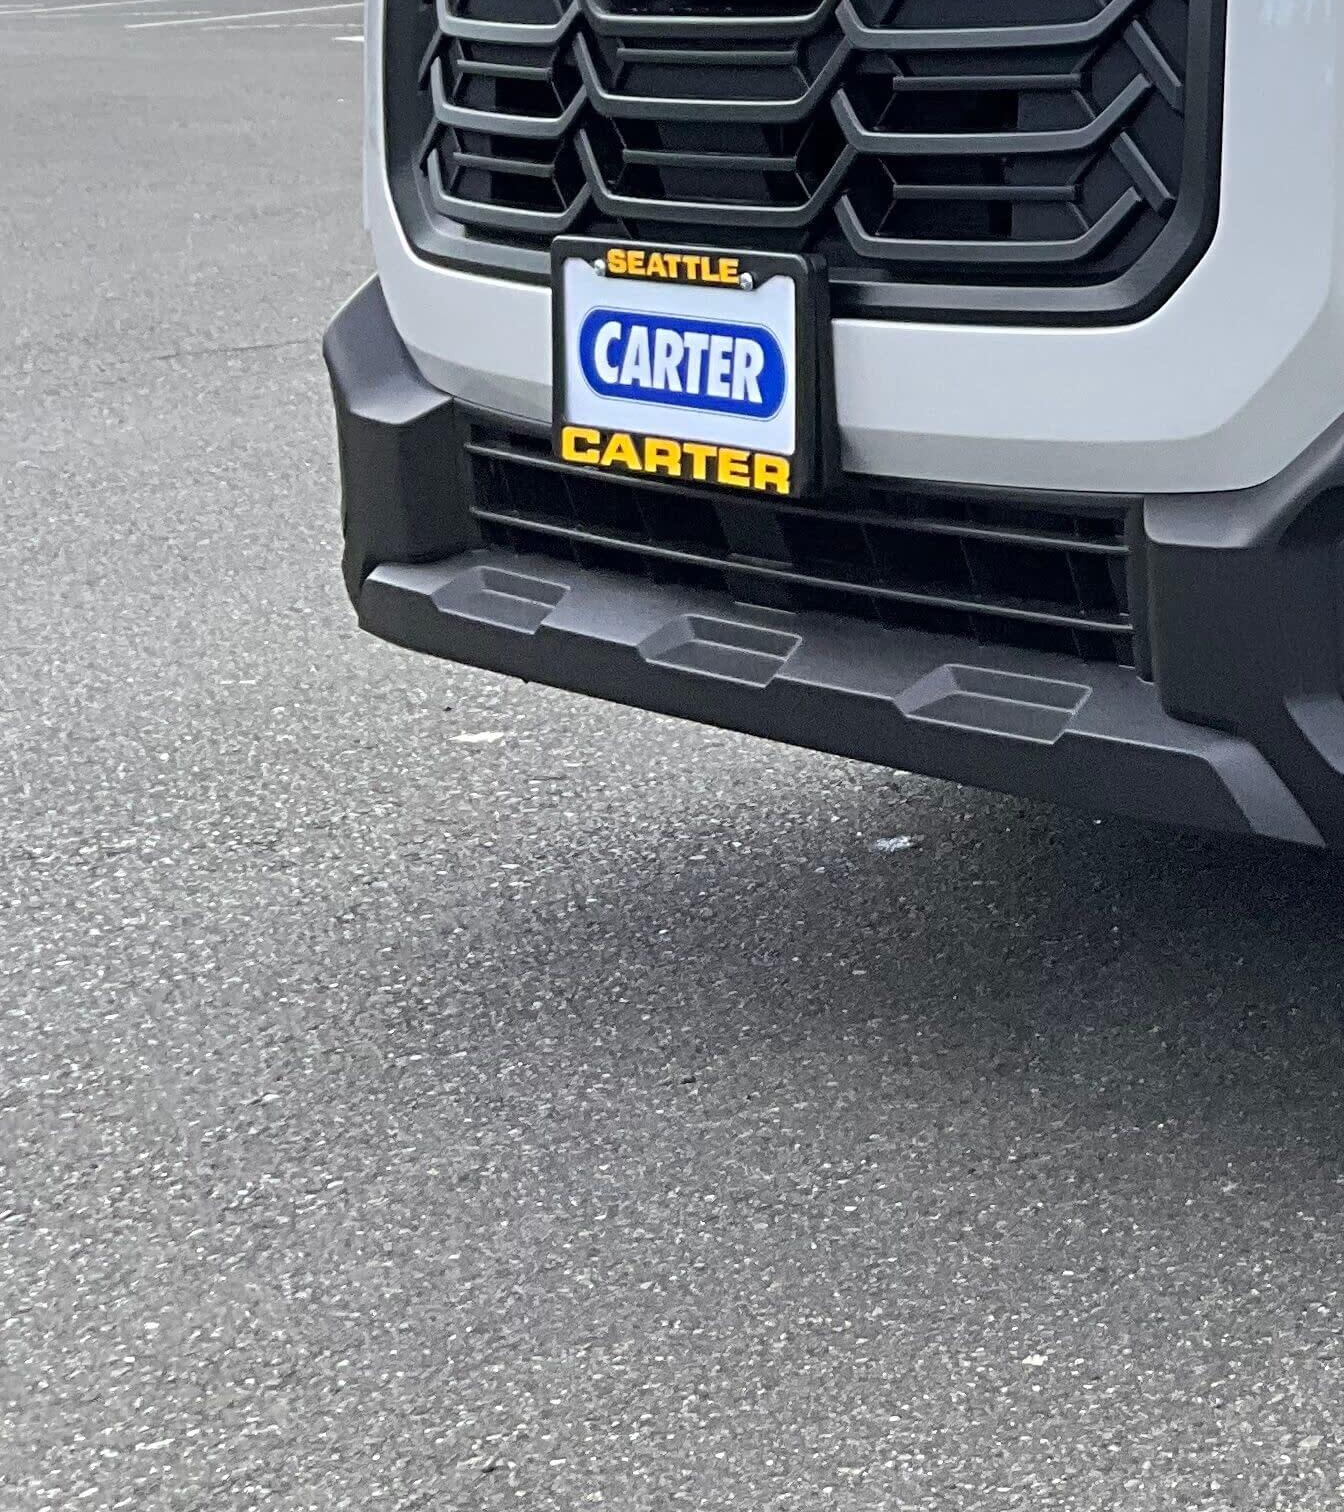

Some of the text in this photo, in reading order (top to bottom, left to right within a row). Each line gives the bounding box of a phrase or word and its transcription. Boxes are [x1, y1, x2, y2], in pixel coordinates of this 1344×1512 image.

[606, 248, 740, 285] SEATTLE
[594, 321, 765, 404] CARTER
[561, 426, 791, 495] CARTER
